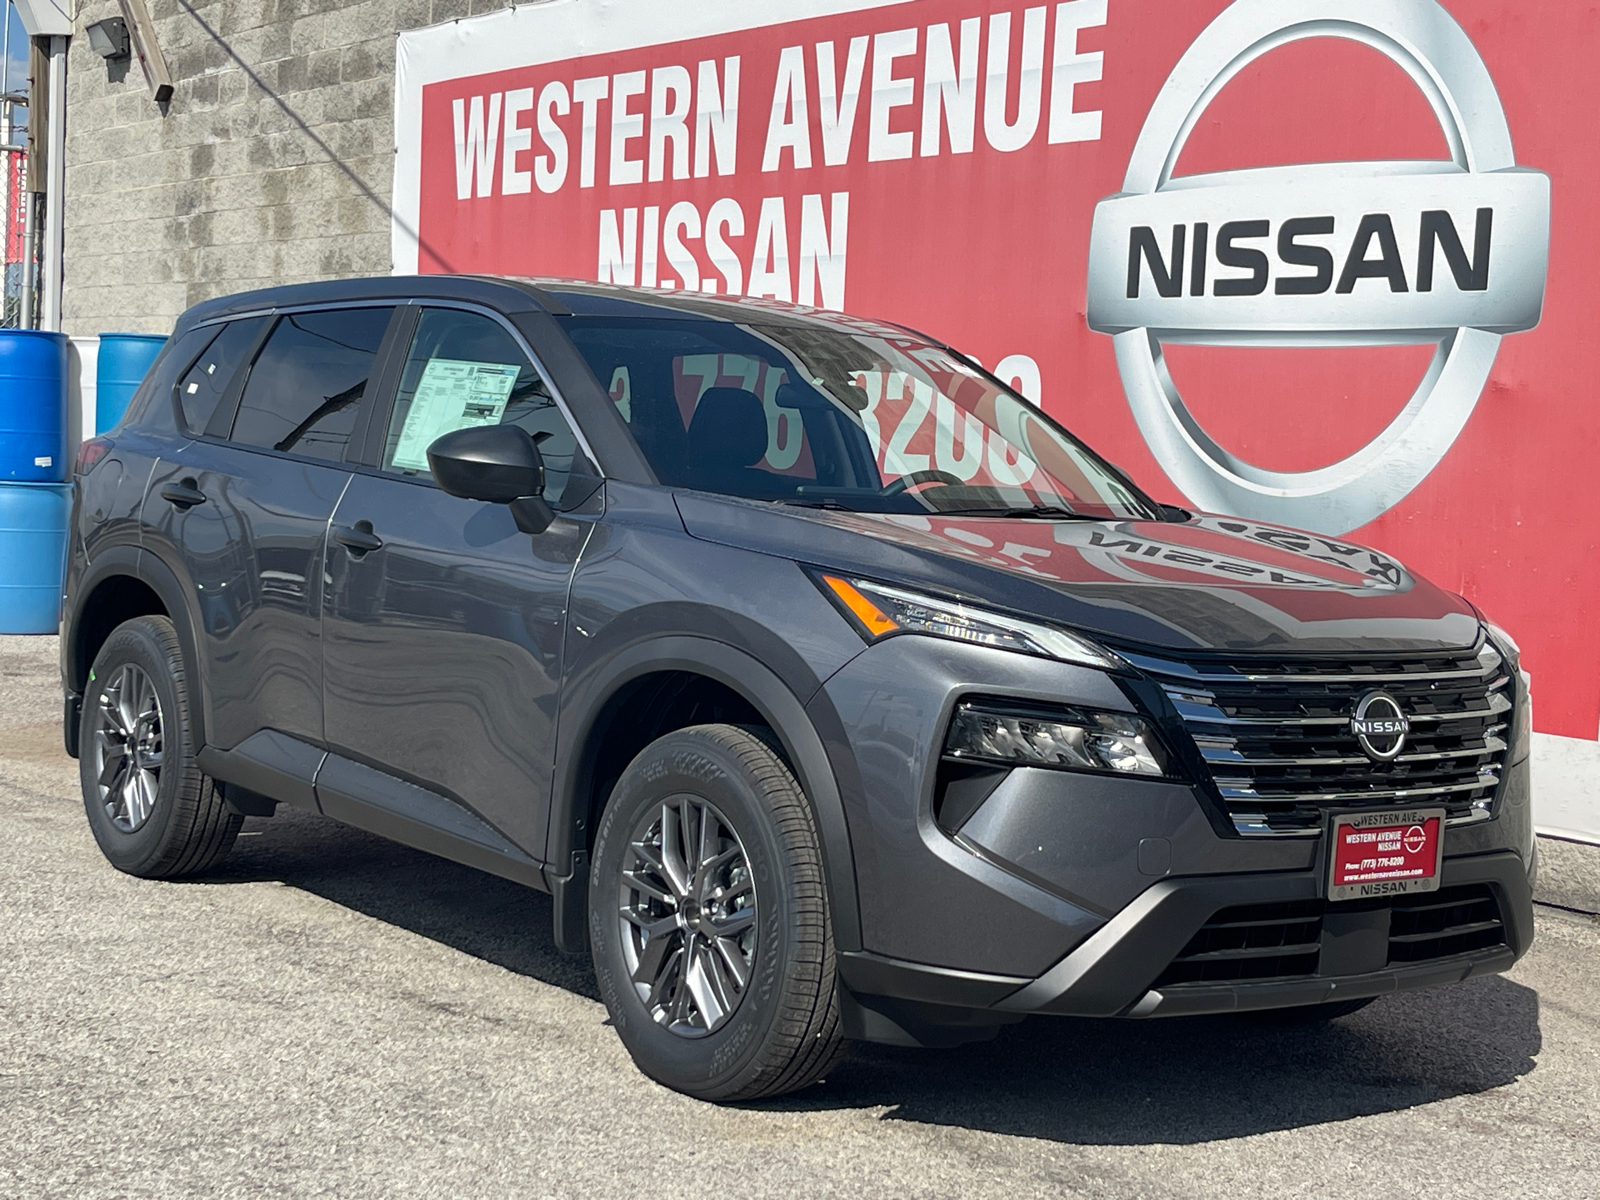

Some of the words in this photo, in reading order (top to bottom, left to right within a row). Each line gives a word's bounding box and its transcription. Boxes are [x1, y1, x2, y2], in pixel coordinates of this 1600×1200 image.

[452, 56, 741, 200] WESTERN
[761, 0, 1108, 173] AVENUE
[599, 192, 849, 313] NISSAN
[1127, 207, 1493, 298] NISSAN
[1354, 721, 1409, 732] NISSAN
[1360, 813, 1399, 826] WESTERN
[1401, 812, 1418, 822] AVE
[1346, 833, 1377, 844] WESTERN
[1377, 831, 1402, 841] AVENUE
[1378, 841, 1401, 851] NISSAN
[1361, 859, 1376, 870] (773)
[1377, 856, 1404, 867] 776-8200
[1361, 882, 1407, 895] NISSAN
